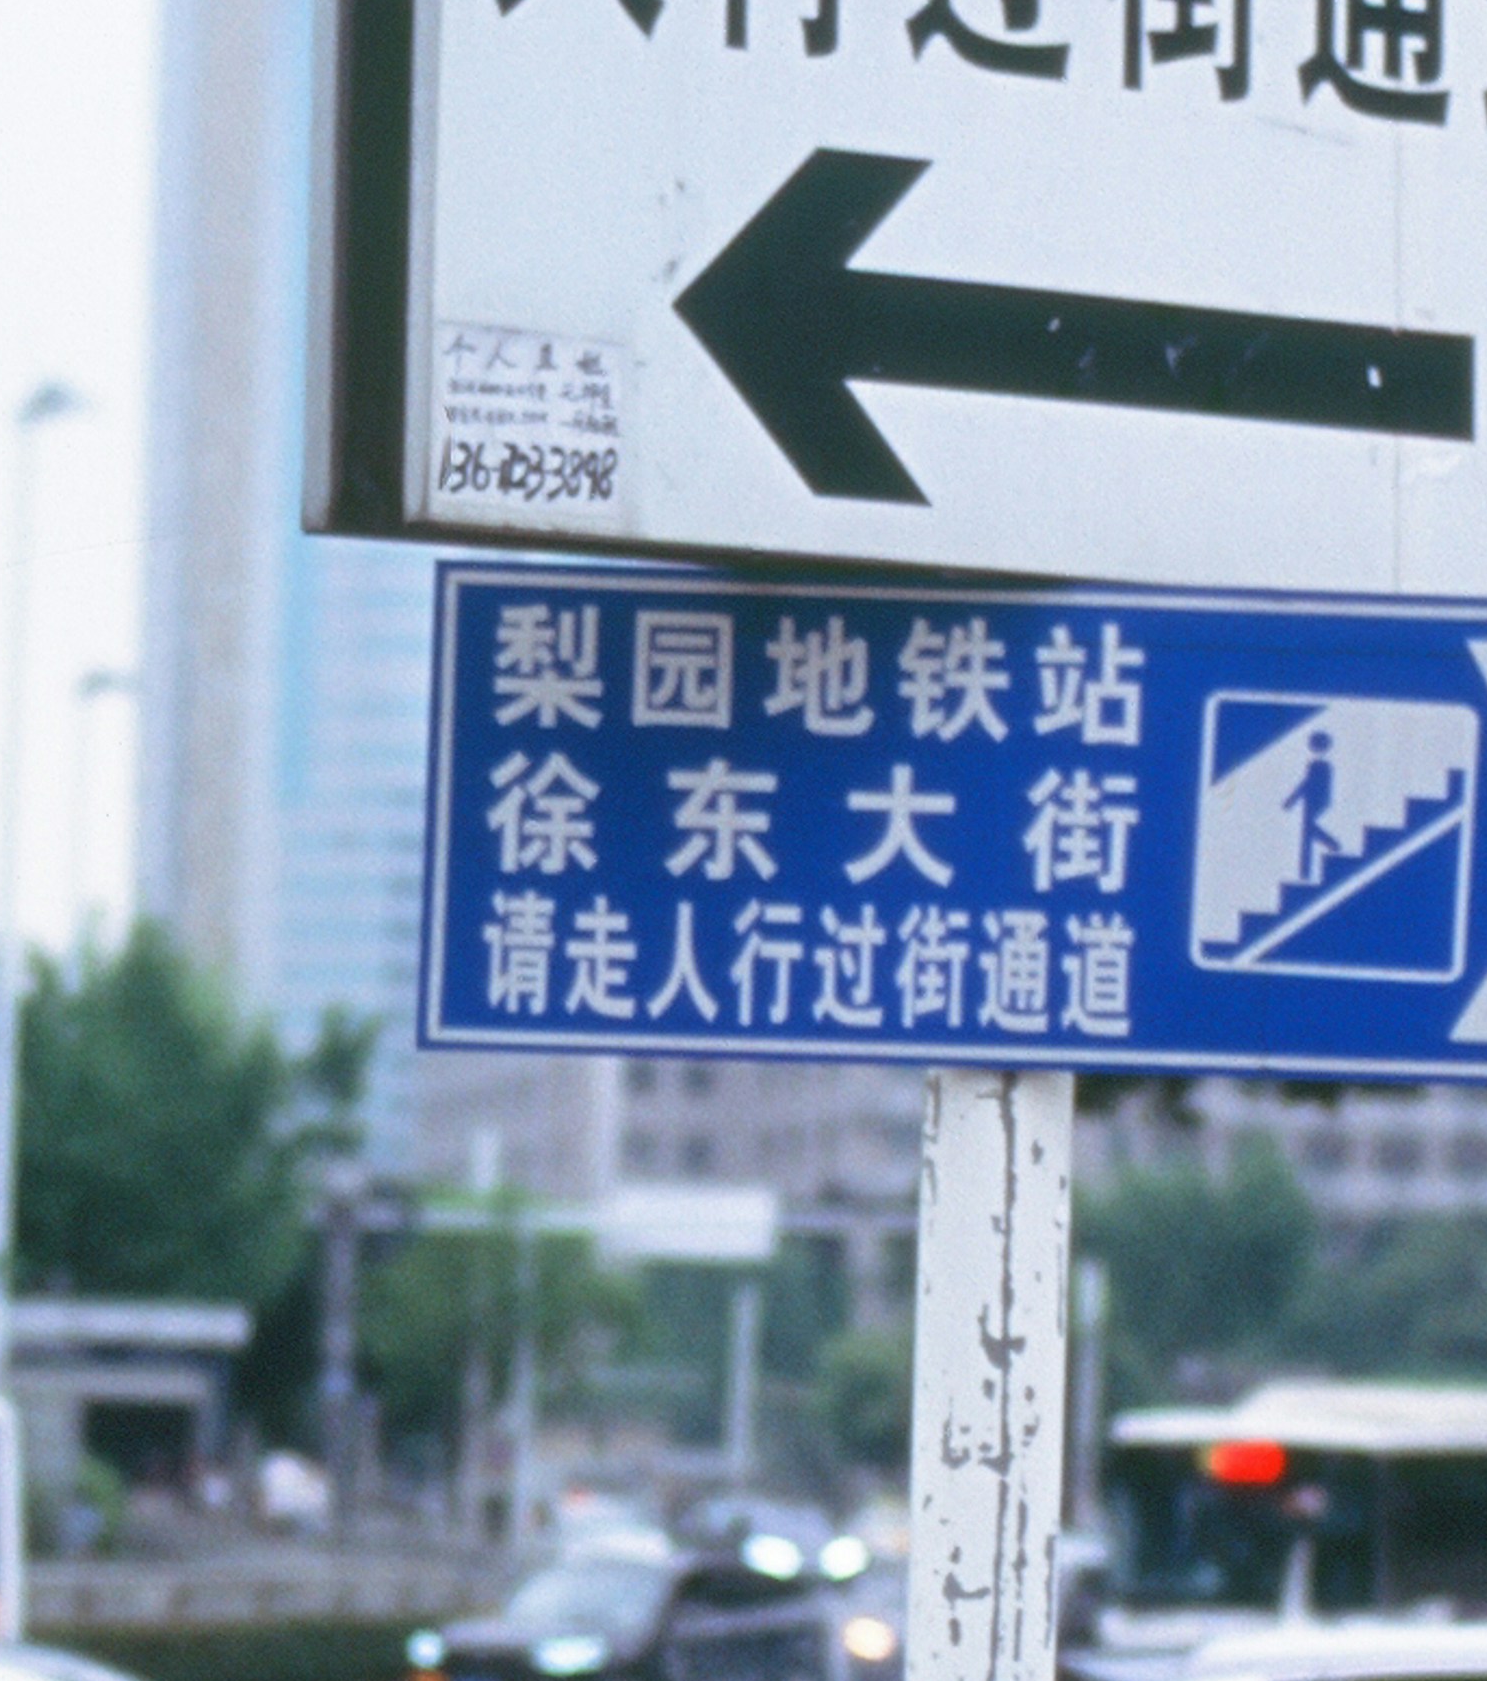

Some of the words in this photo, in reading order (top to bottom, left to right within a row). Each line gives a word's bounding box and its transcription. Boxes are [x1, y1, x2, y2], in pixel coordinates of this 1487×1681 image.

[494, 602, 1147, 747] 梨园地铁站
[487, 750, 1142, 894] 徐东大街
[482, 892, 1135, 1037] 请走人行过街通道
